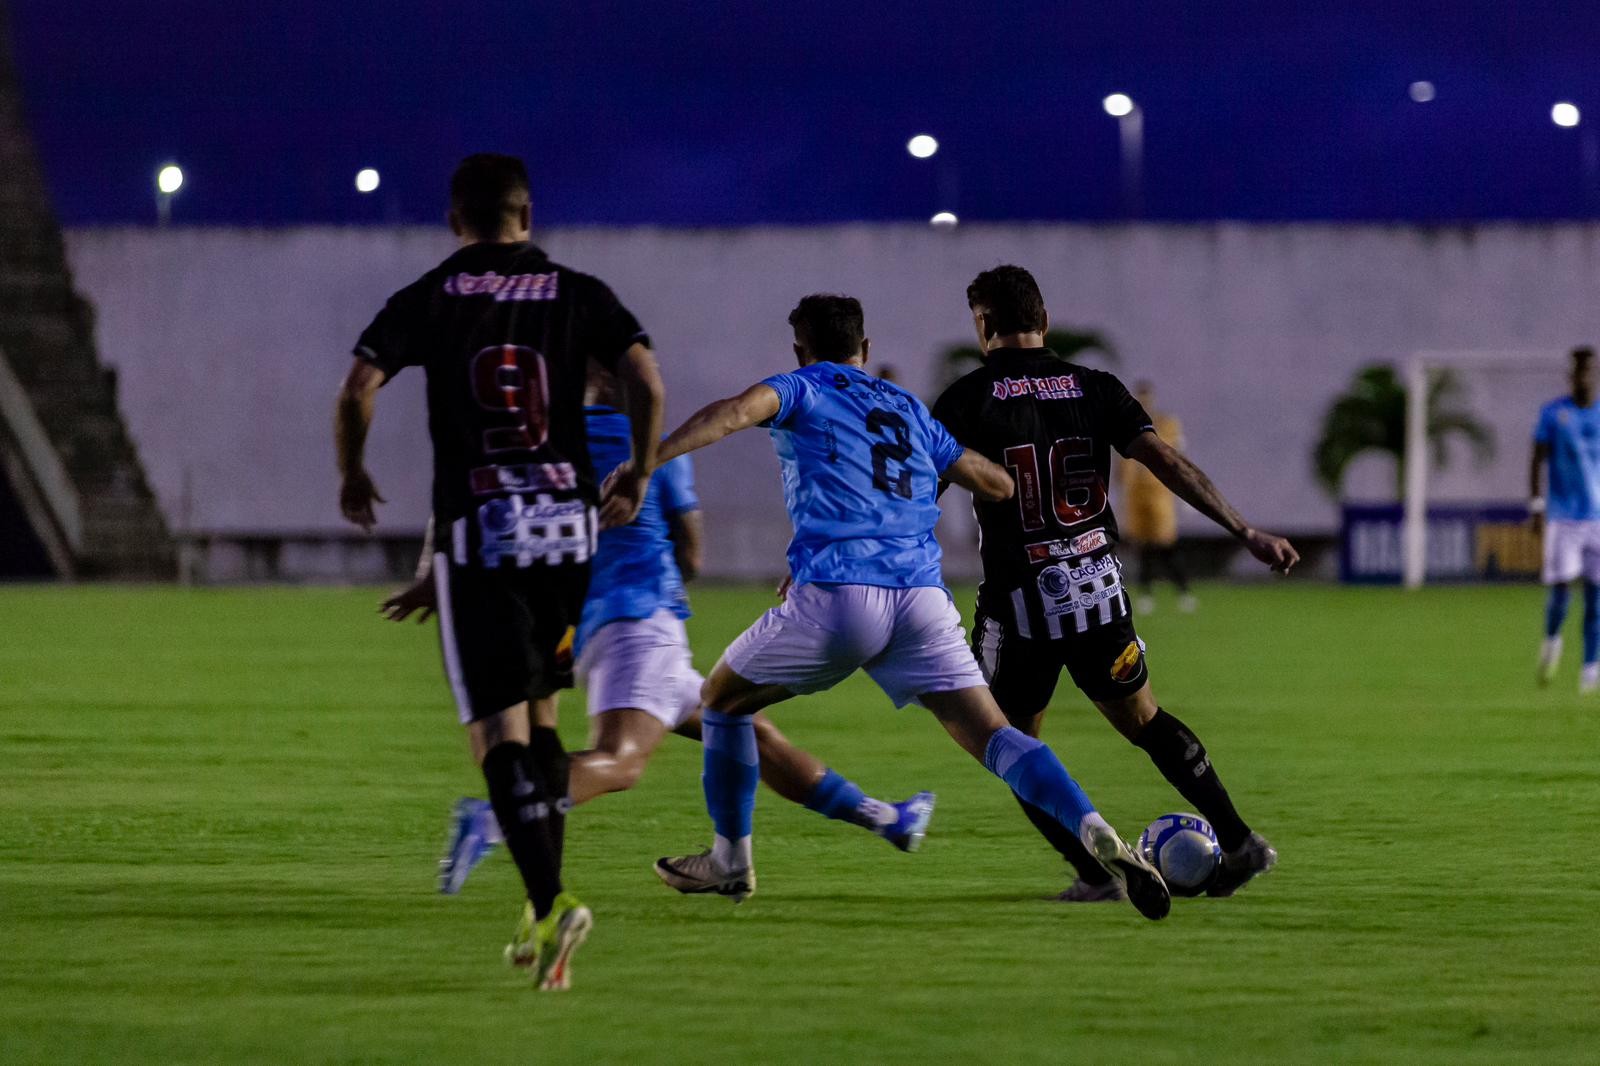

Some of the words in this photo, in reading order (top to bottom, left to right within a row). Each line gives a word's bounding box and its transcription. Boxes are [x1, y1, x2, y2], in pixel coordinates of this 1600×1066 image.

[471, 344, 549, 452] 9
[866, 407, 912, 500] 2
[1003, 437, 1107, 532] 16
[1069, 558, 1113, 580] CAGEPA
